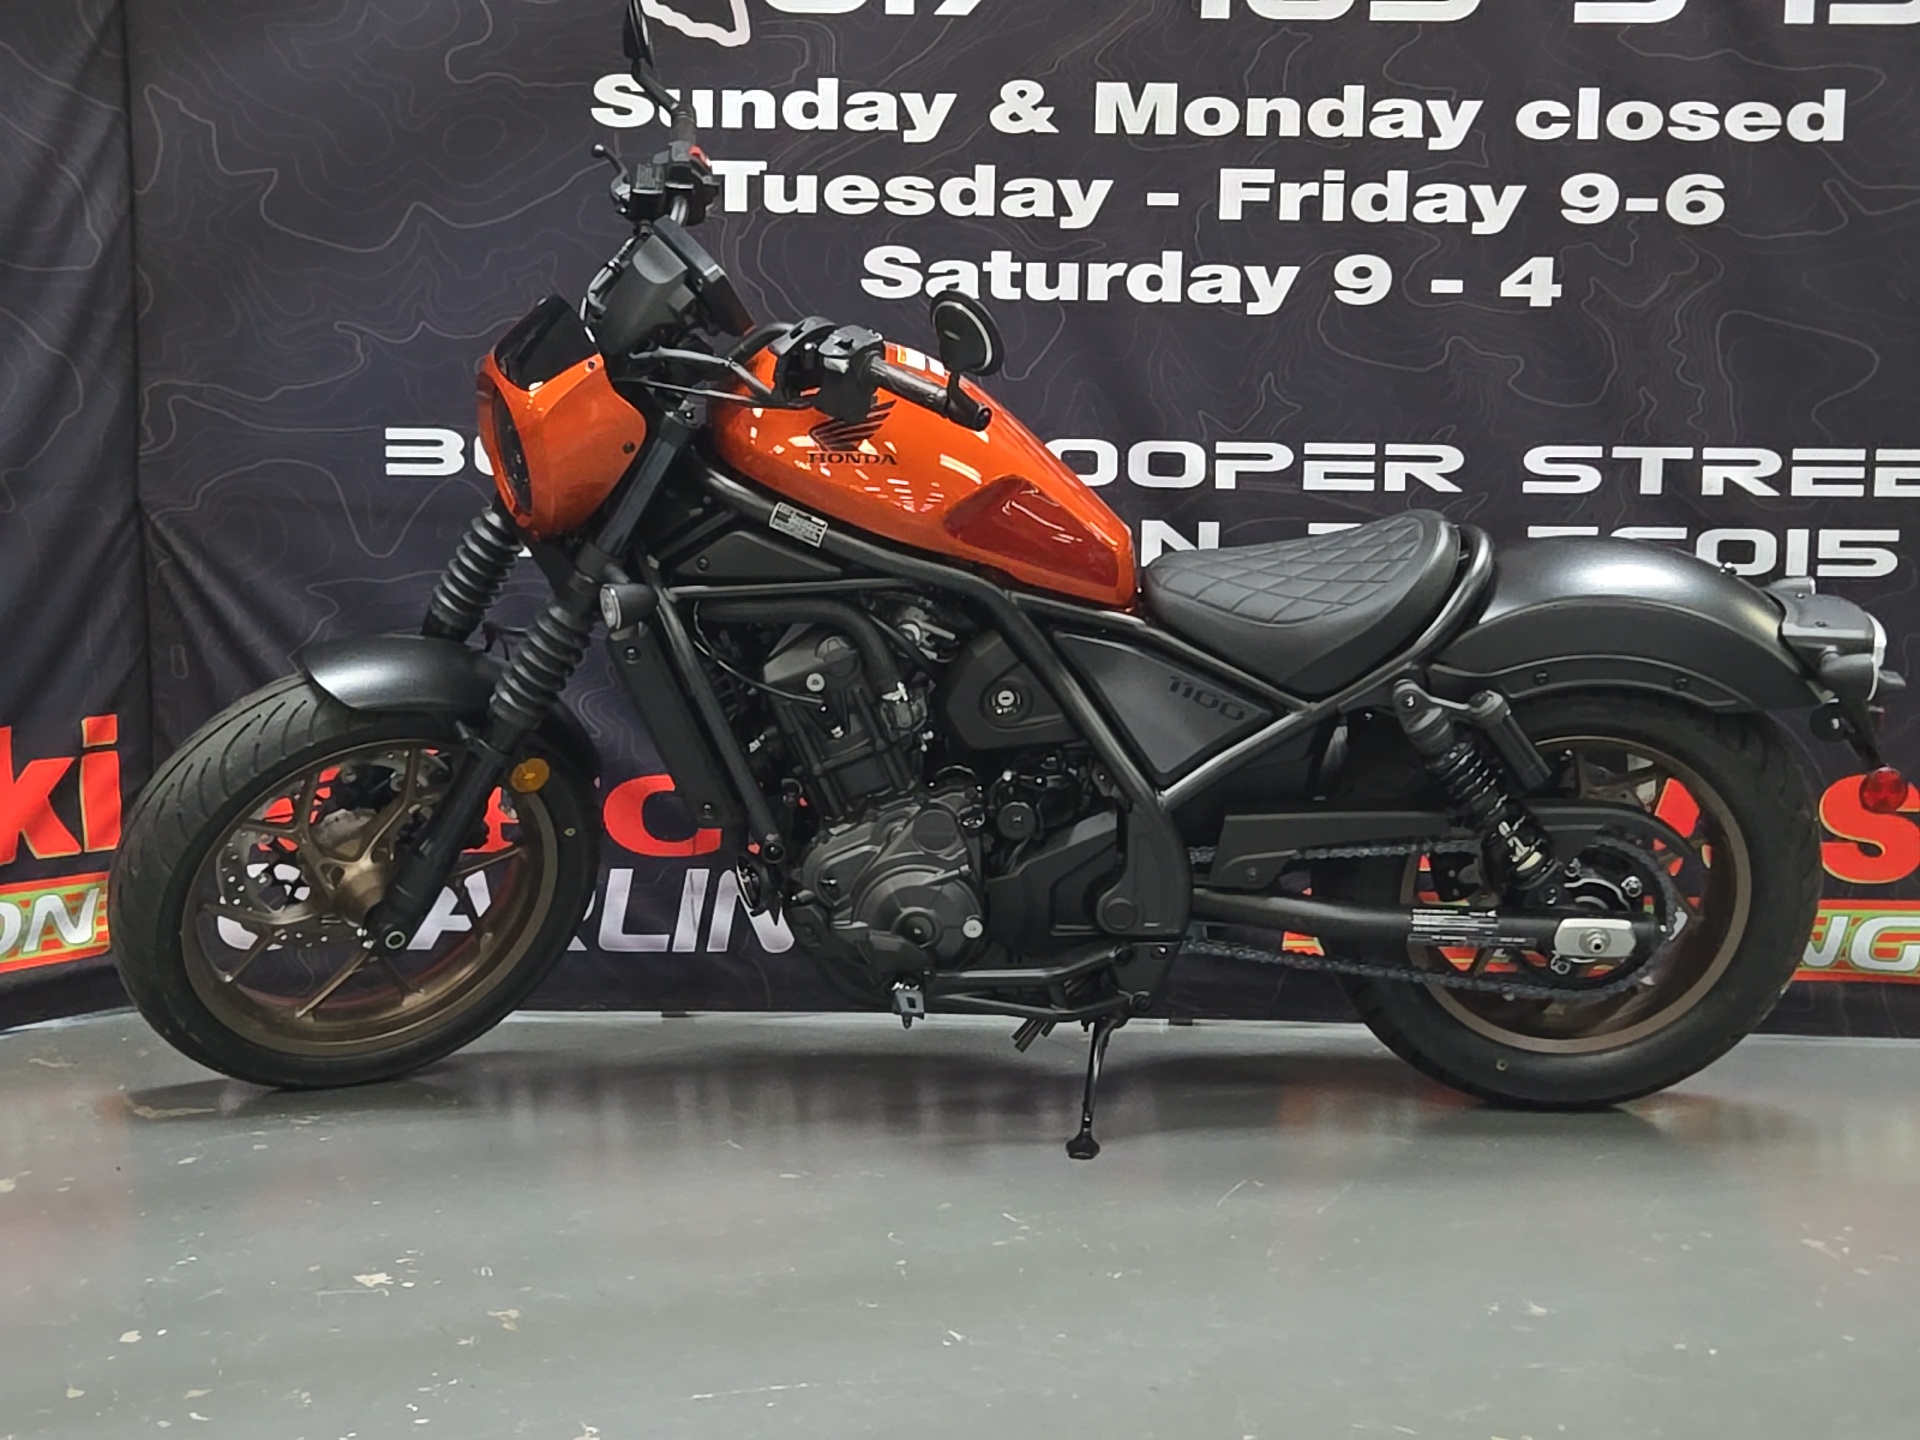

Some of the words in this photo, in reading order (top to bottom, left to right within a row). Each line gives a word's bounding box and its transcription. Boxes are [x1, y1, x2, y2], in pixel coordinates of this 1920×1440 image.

[591, 74, 957, 143] Sunday
[990, 80, 1059, 133] &
[1095, 82, 1483, 150] Monday
[1516, 88, 1846, 142] closed
[711, 158, 1114, 228] Tuesday
[1147, 193, 1179, 206] -
[1219, 168, 1527, 234] Friday
[1561, 173, 1724, 225] 9-6
[861, 246, 1300, 315] Saturday
[1334, 254, 1392, 305] 9
[1431, 280, 1463, 293] -
[1500, 257, 1562, 306] 4
[808, 452, 898, 466] HONDA
[1041, 438, 1464, 492] OOPER
[1528, 526, 1899, 577] 015
[1169, 675, 1246, 721] 1100
